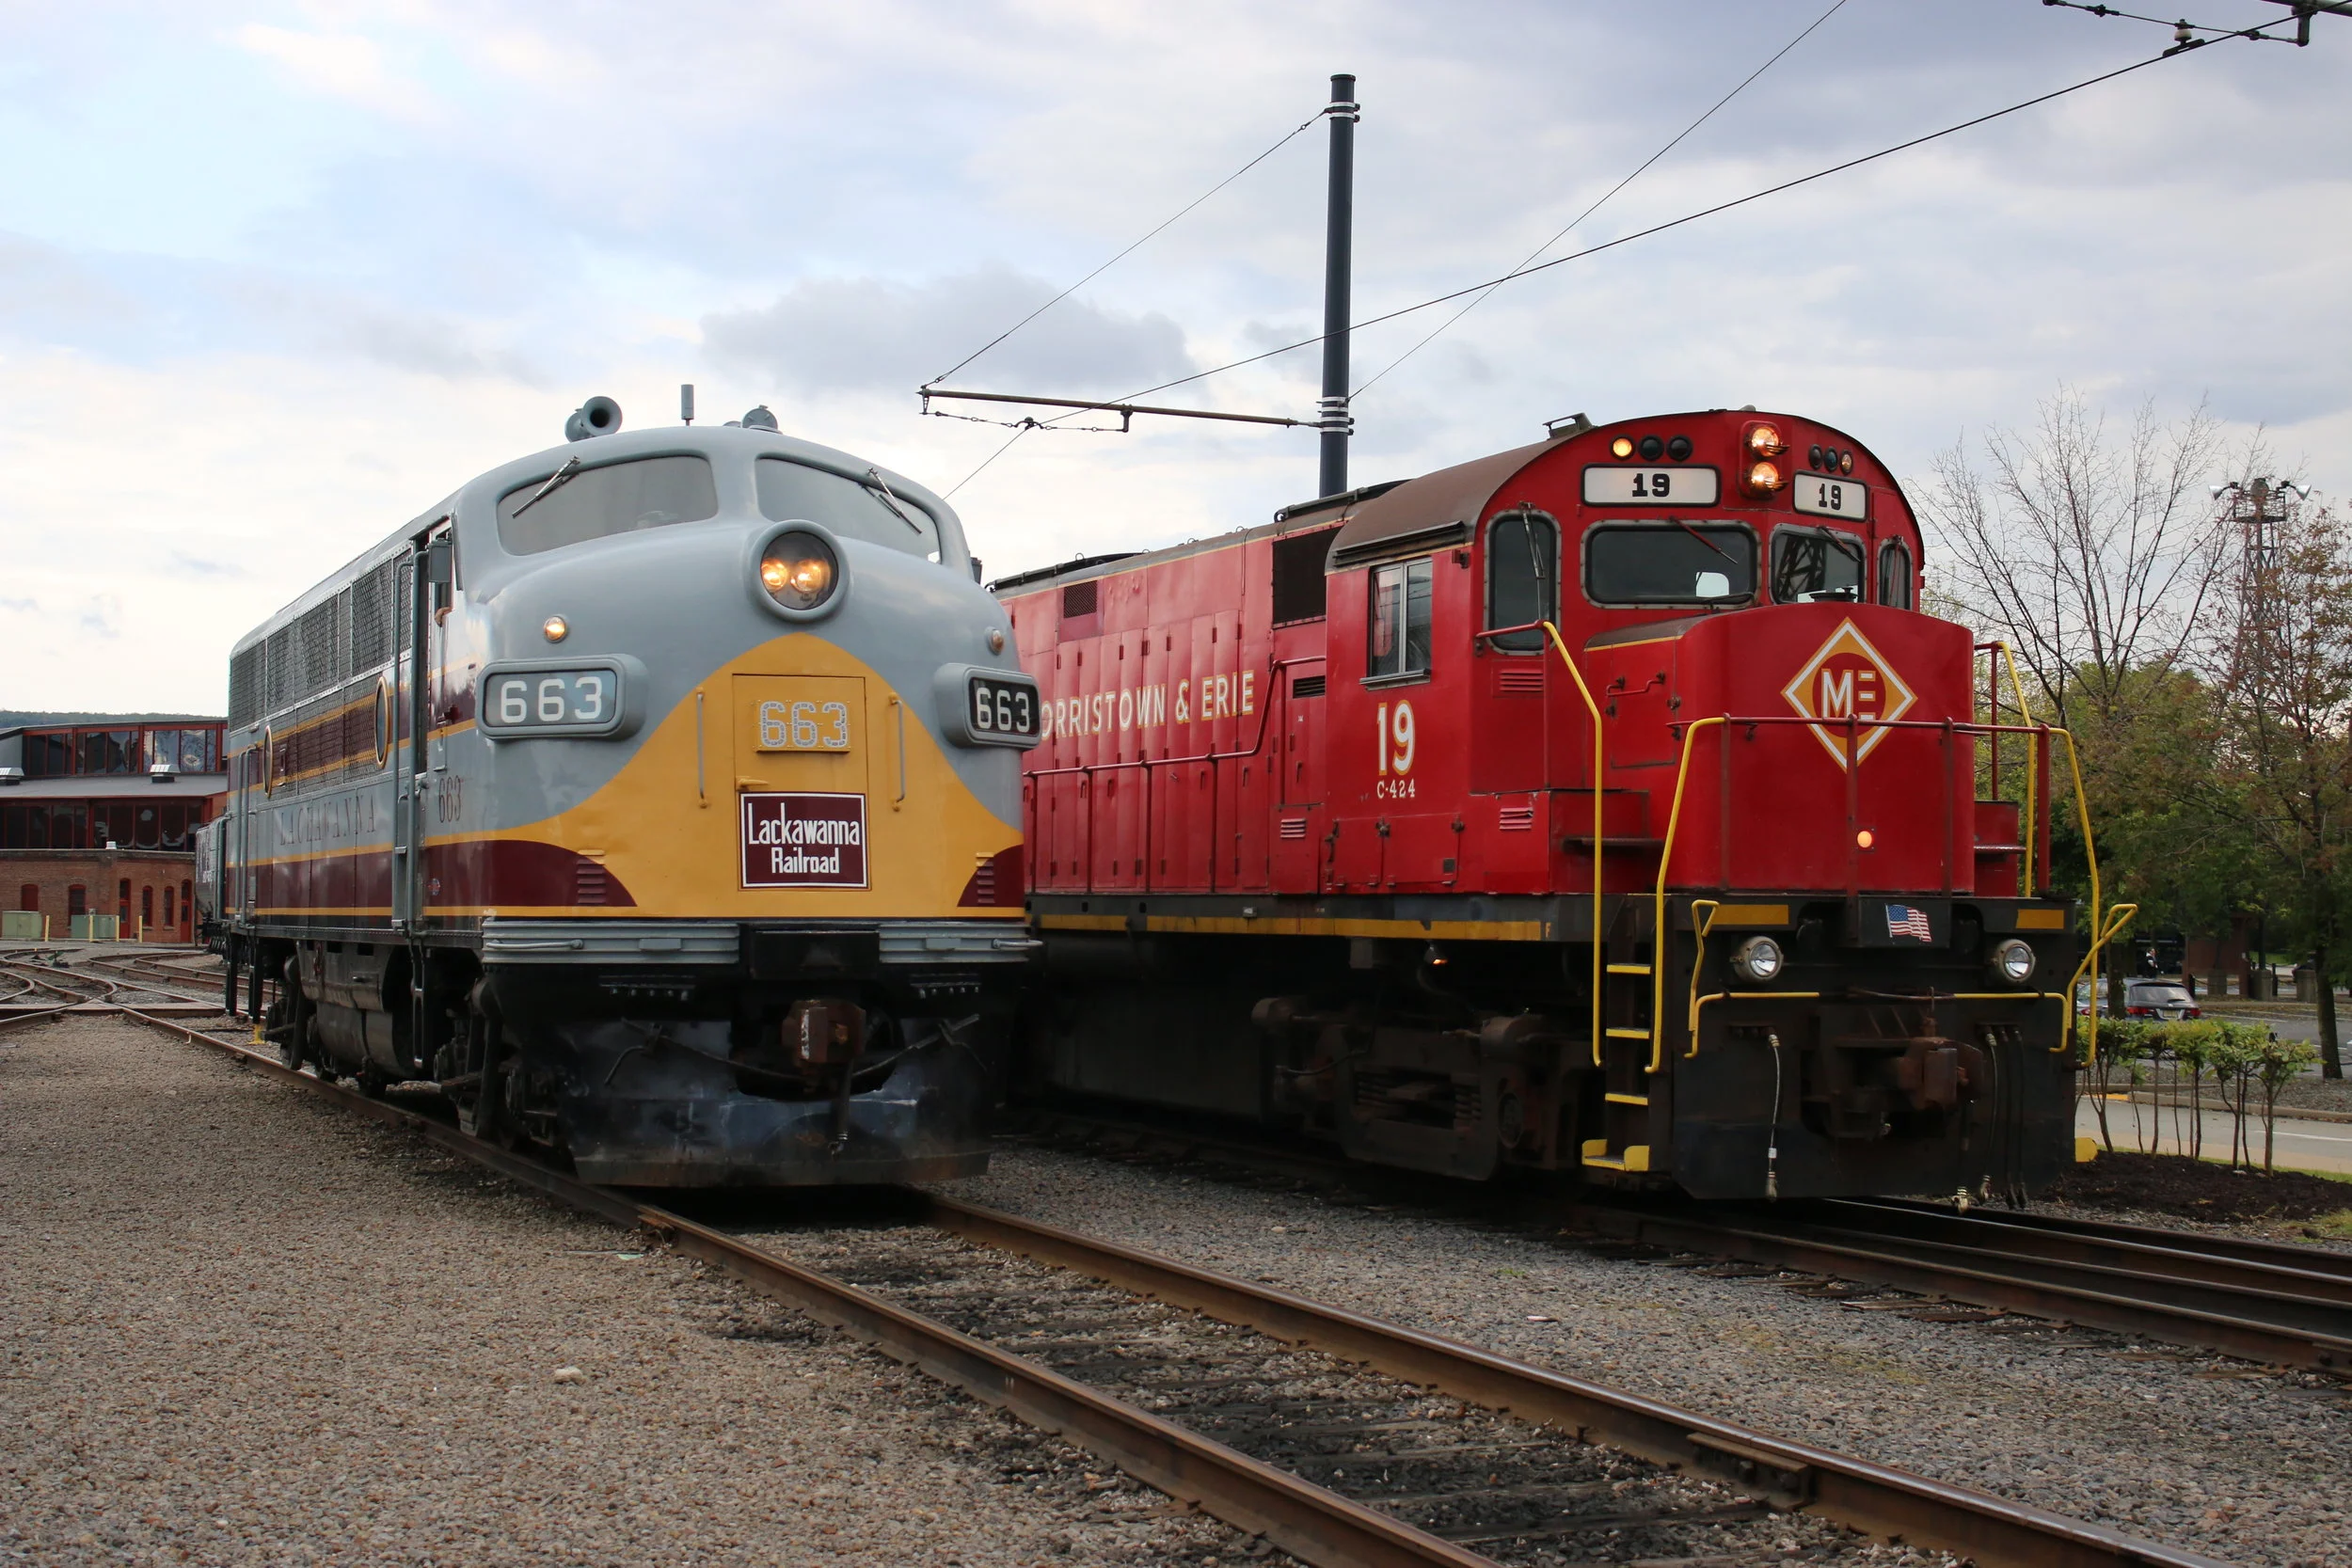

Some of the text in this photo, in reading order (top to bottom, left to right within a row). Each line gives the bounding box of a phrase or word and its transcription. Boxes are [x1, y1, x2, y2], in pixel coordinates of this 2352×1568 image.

[1631, 472, 1671, 498] 19
[1818, 483, 1842, 511] 19
[500, 676, 603, 723] 663
[976, 687, 1030, 733] 663
[1175, 678, 1190, 725] &
[1200, 669, 1255, 721] ERIE
[759, 701, 848, 748] 663
[1376, 699, 1415, 776] 19
[438, 775, 462, 823] 663
[1376, 778, 1416, 800] C-424
[748, 802, 860, 846] Lackawanna
[771, 847, 840, 874] Railroad
